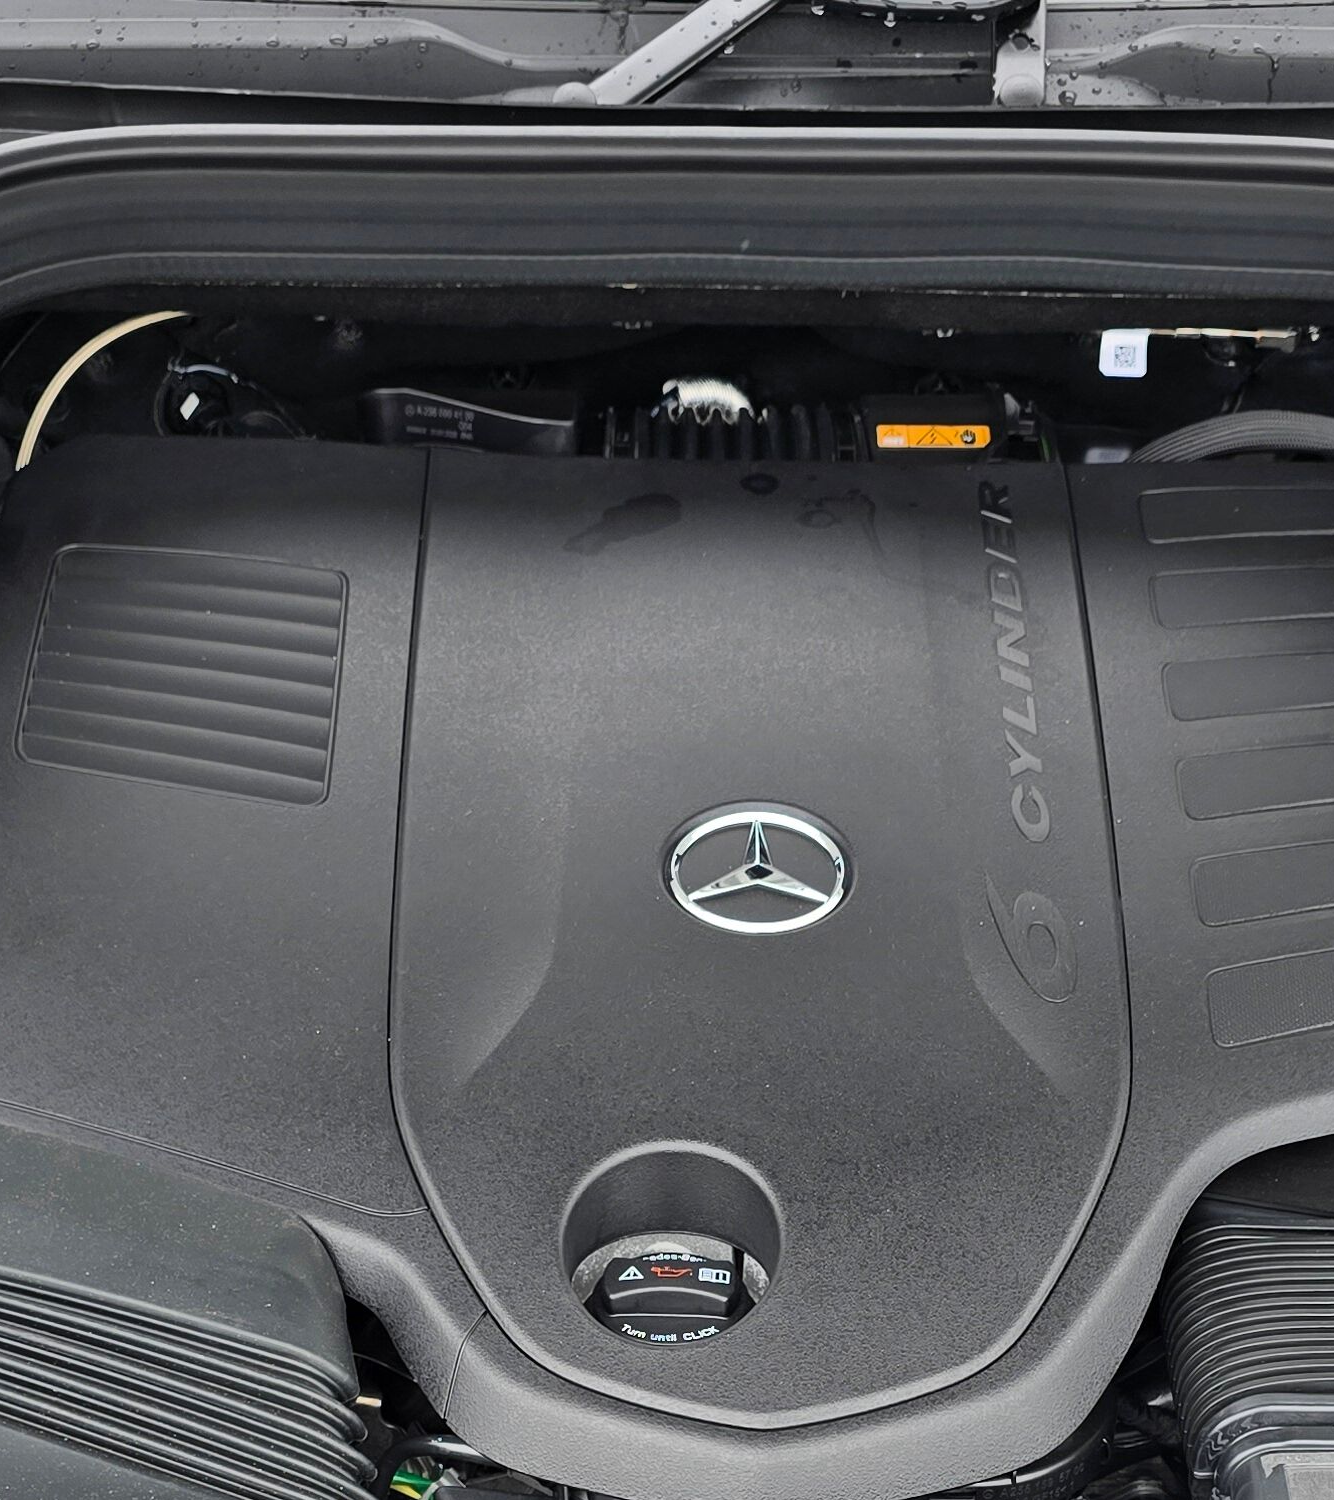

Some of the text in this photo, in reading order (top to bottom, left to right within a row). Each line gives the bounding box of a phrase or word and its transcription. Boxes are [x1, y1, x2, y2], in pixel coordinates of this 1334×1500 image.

[980, 479, 1078, 1003] 6 CYLINDER
[620, 1323, 720, 1343] Turn until CLICK
